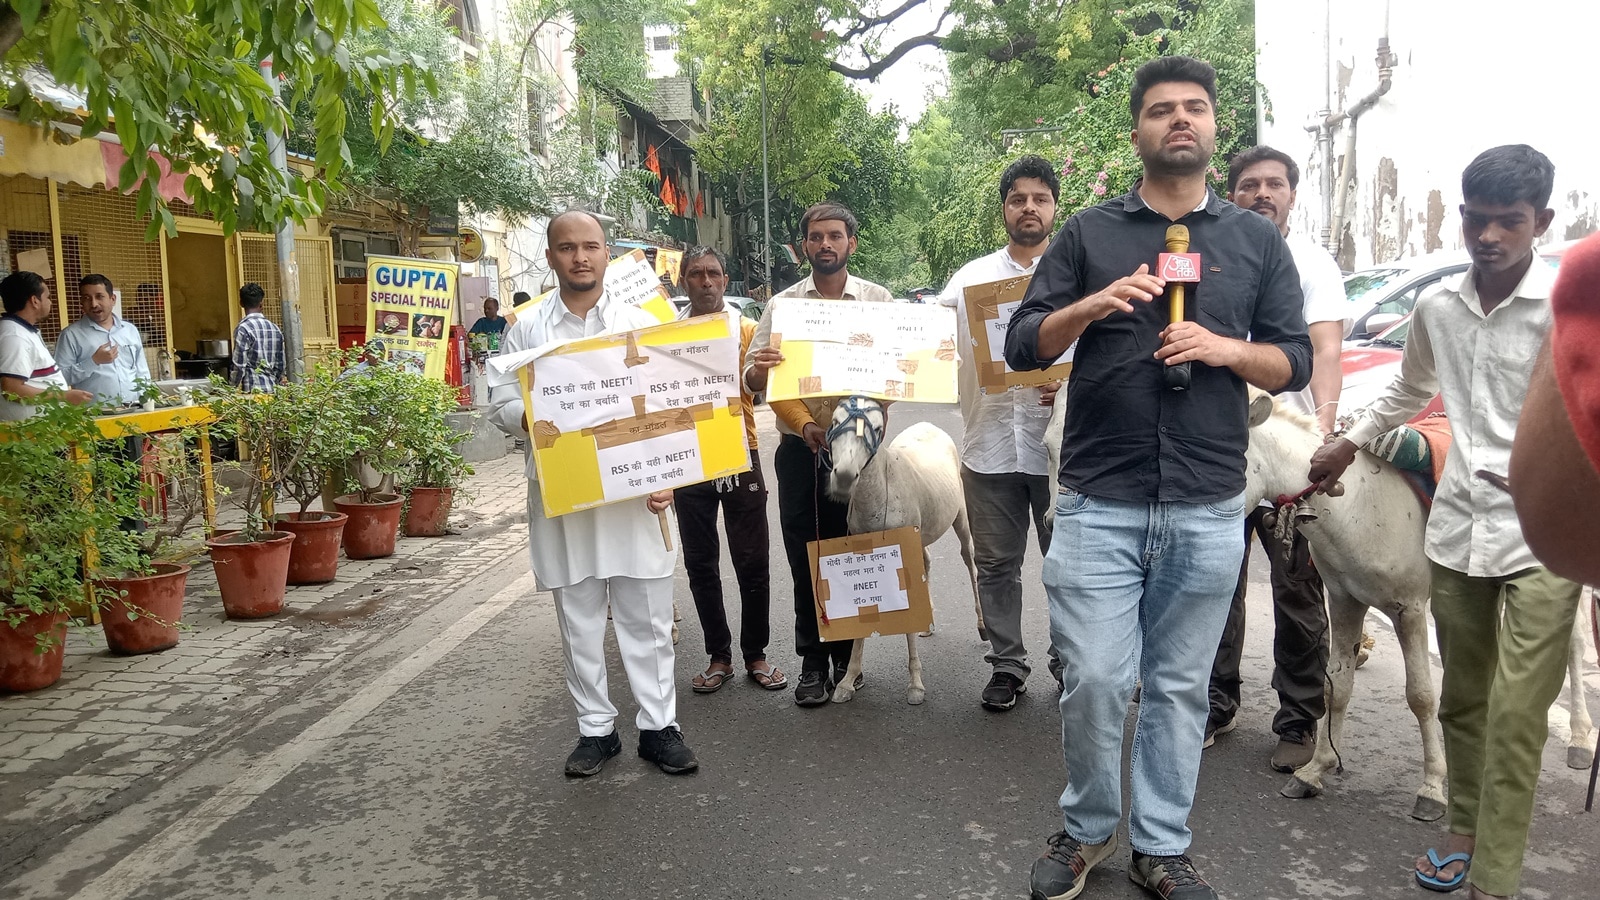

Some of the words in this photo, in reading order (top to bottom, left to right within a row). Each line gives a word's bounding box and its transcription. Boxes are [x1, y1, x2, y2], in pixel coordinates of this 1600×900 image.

[376, 266, 448, 292] GUPTA
[634, 277, 647, 288] 719
[371, 291, 417, 307] SPECIAL
[420, 296, 451, 310] THALI
[670, 348, 681, 357] का
[686, 345, 709, 355] मॉडल
[542, 385, 562, 397] RSS
[564, 383, 576, 394] की
[580, 381, 596, 391] यही
[650, 382, 668, 394] RSS
[669, 380, 680, 391] की
[684, 377, 699, 388] यही
[560, 400, 574, 411] देश
[579, 399, 591, 409] का
[666, 397, 679, 407] देश
[683, 396, 694, 405] का
[611, 463, 629, 476] RSS
[631, 460, 642, 471] की
[646, 456, 661, 467] यही
[628, 477, 642, 488] देश
[646, 475, 657, 484] का
[826, 558, 841, 567] मोदी
[844, 555, 853, 564] जी
[890, 549, 899, 558] भी
[853, 580, 878, 591] #NEET
